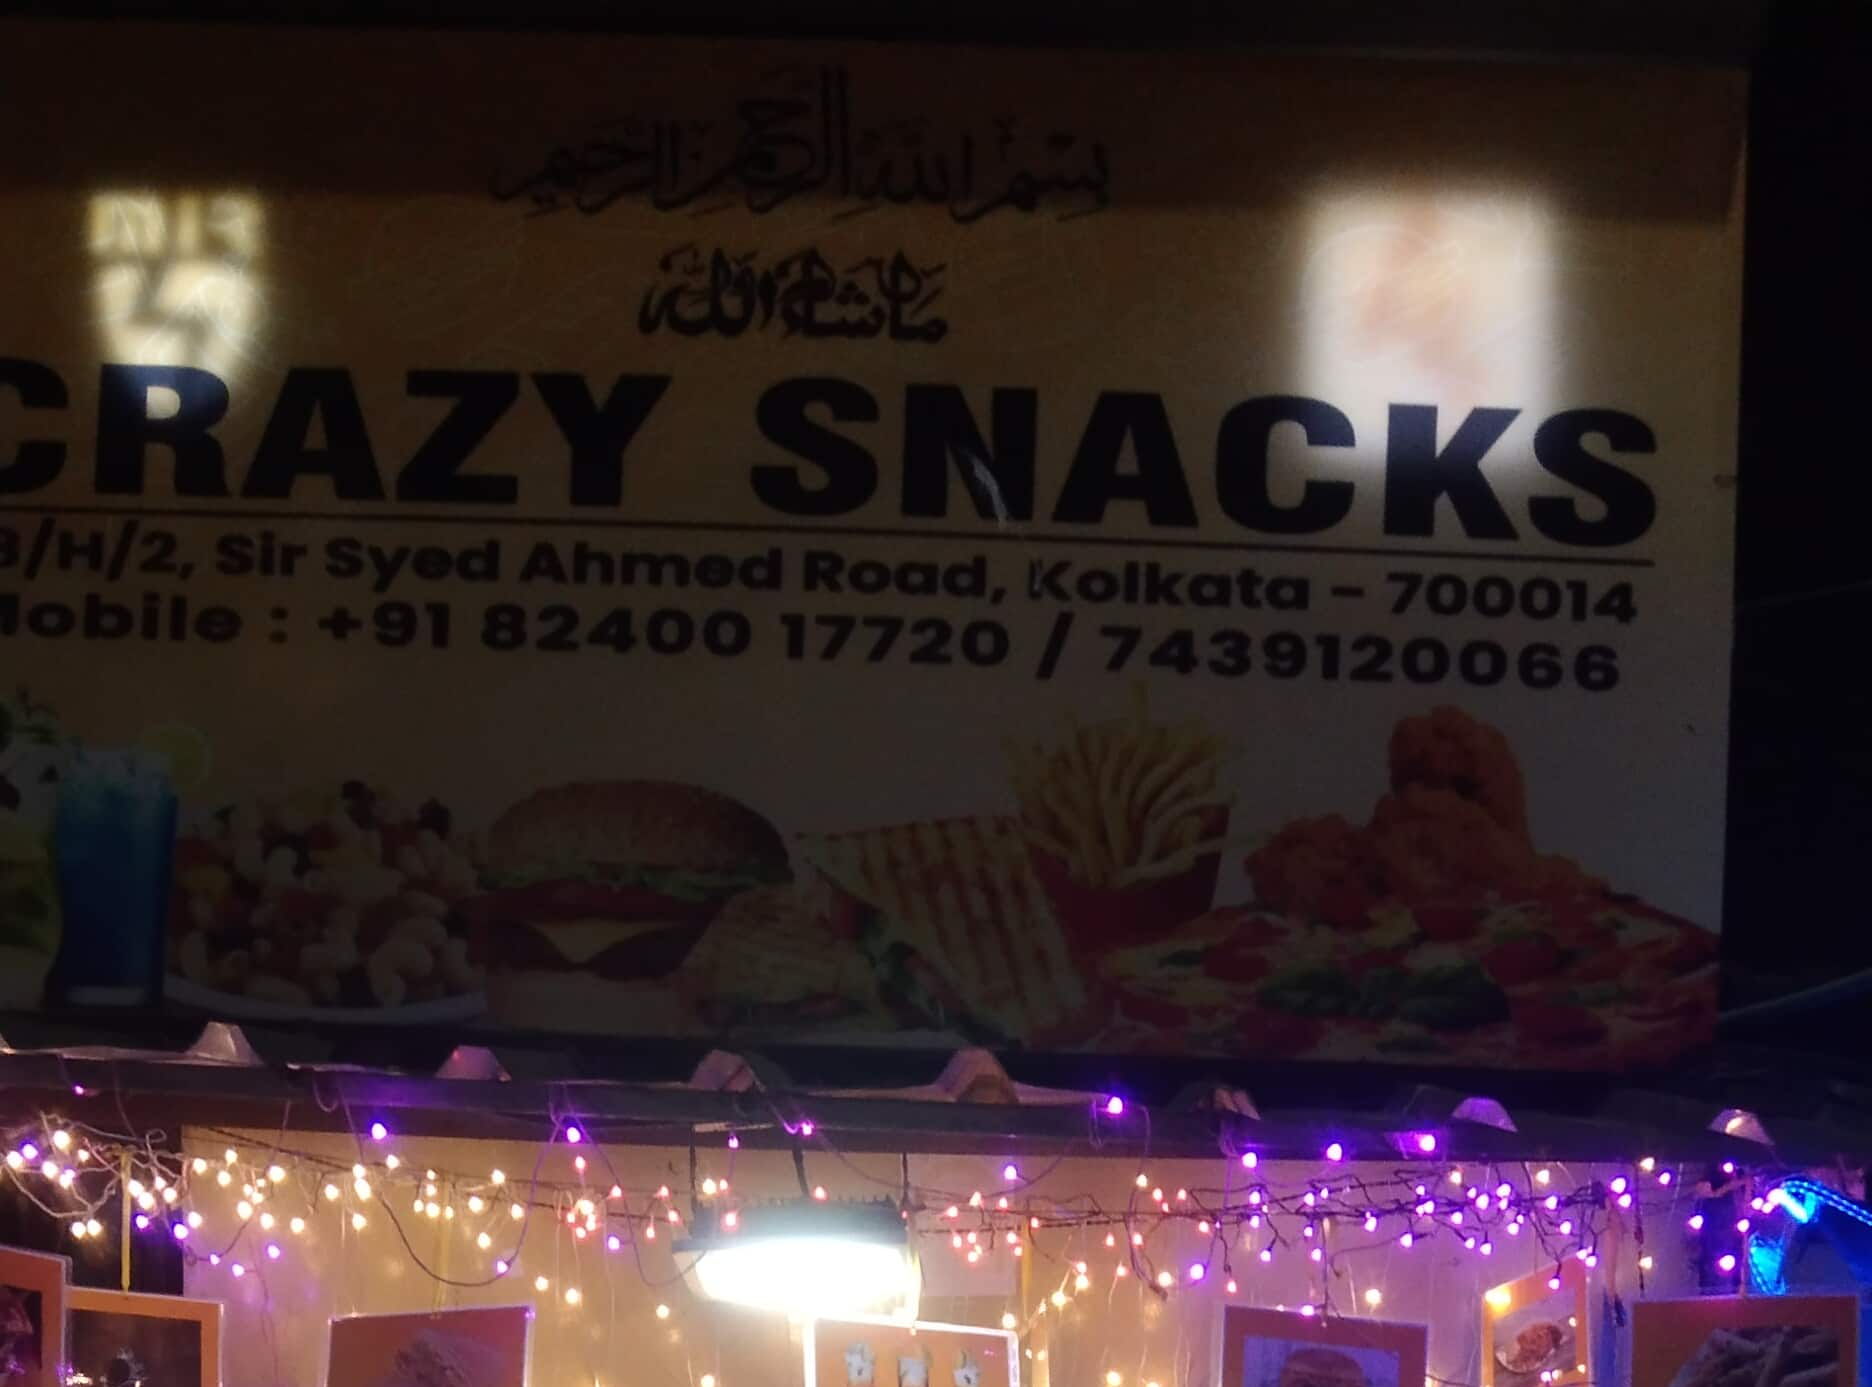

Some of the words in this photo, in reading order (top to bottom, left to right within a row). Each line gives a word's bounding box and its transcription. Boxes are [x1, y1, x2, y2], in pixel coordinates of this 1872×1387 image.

[750, 376, 1657, 547] SNACKS
[216, 532, 307, 577] Sir
[325, 537, 501, 592] Syed
[519, 543, 782, 590] Ahmed
[803, 554, 1007, 606] Road,
[1028, 558, 1310, 610] Kolkata
[1385, 572, 1638, 624] 700014
[271, 606, 290, 645] :
[318, 600, 450, 651] +91
[481, 602, 752, 655] 82400
[779, 612, 1010, 668] 17720
[1035, 610, 1076, 681] /
[1100, 624, 1621, 692] 7439120066
